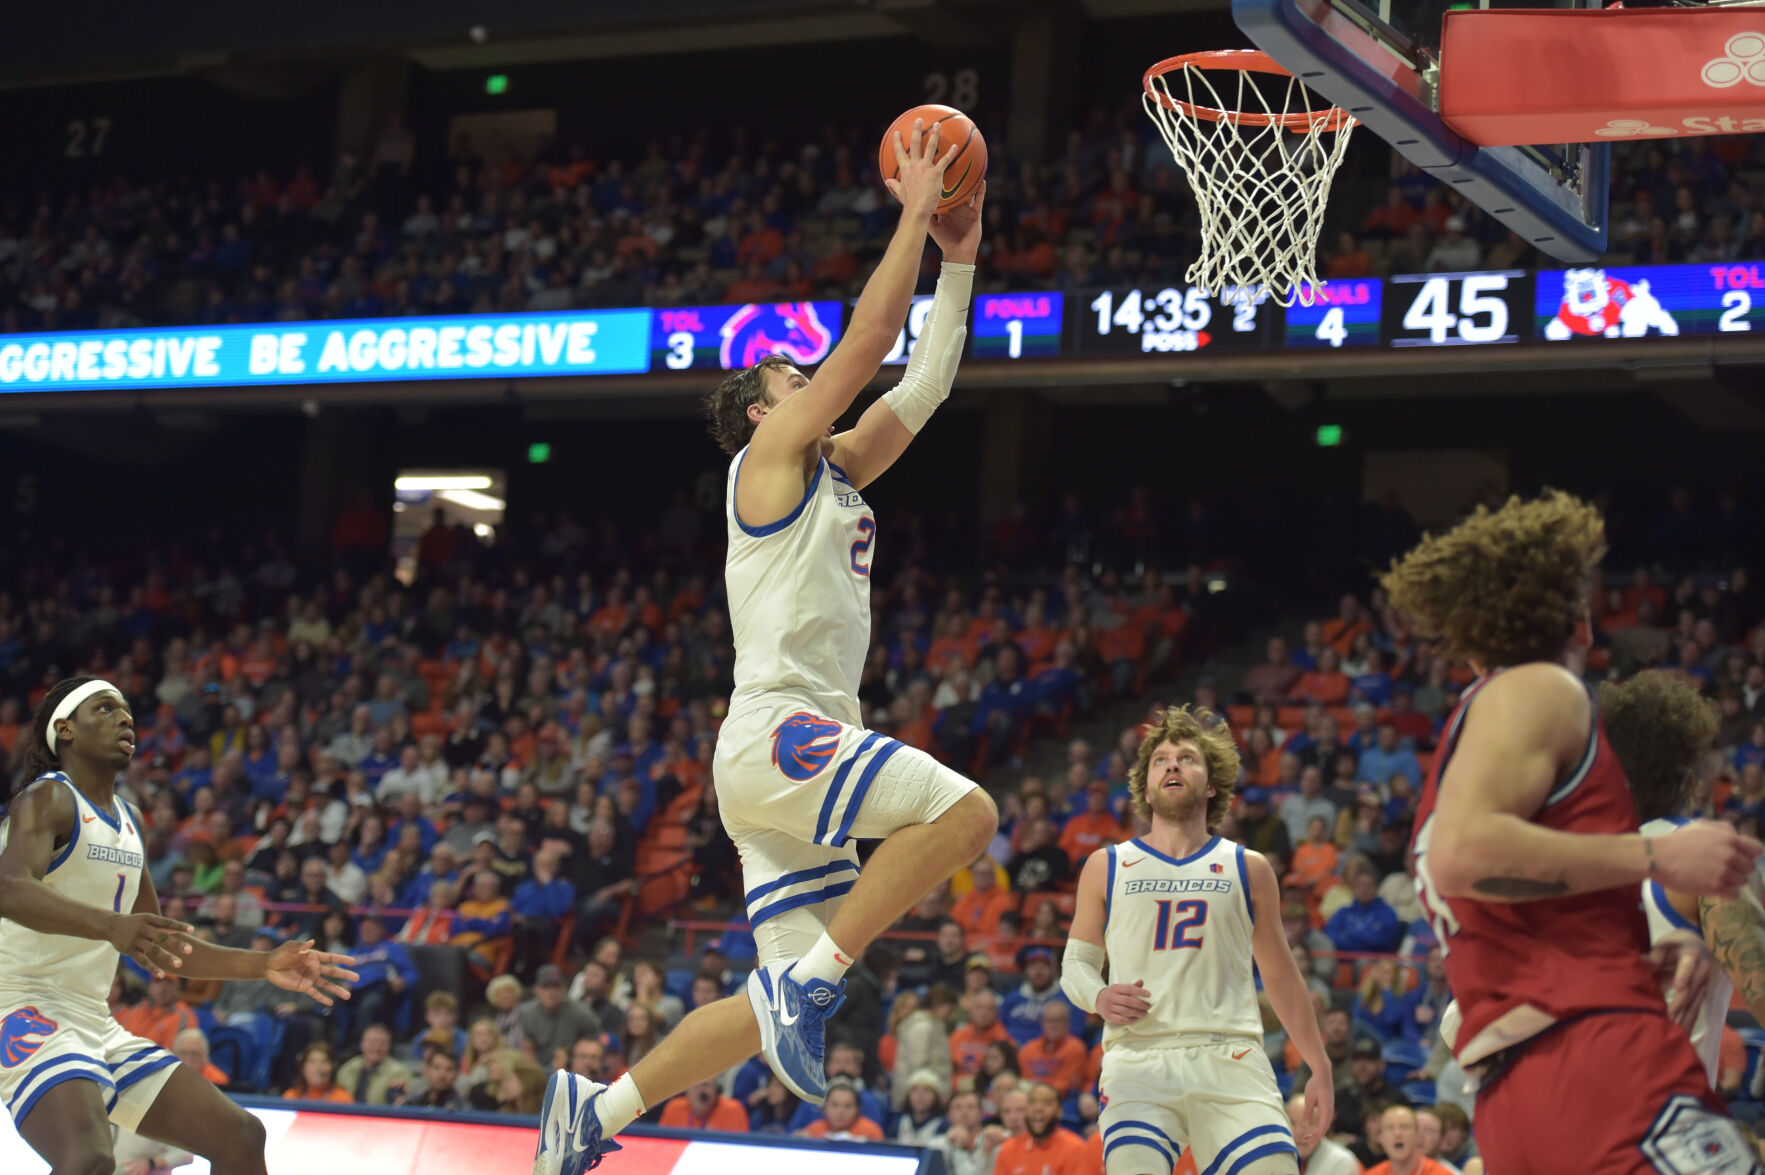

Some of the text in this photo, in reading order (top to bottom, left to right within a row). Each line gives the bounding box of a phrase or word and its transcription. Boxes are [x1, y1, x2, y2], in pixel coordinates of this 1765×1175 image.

[923, 69, 979, 112] 28
[64, 117, 113, 157] 27
[1682, 115, 1765, 134] Sta
[1710, 266, 1765, 290] TOL
[660, 311, 705, 333] TOL
[985, 297, 1052, 319] FOULS
[1091, 287, 1212, 335] 14:35
[1233, 303, 1257, 332] 2
[1315, 307, 1348, 348] 4
[1402, 275, 1510, 343] 45
[1718, 289, 1752, 331] 2
[0, 321, 598, 383] GGRESSIVE BE AGGRESSIVE
[665, 332, 695, 370] 3
[1005, 319, 1023, 359] 1
[87, 844, 143, 868] BRONCOS
[1125, 879, 1231, 895] BRONCOS
[1153, 899, 1209, 951] 12
